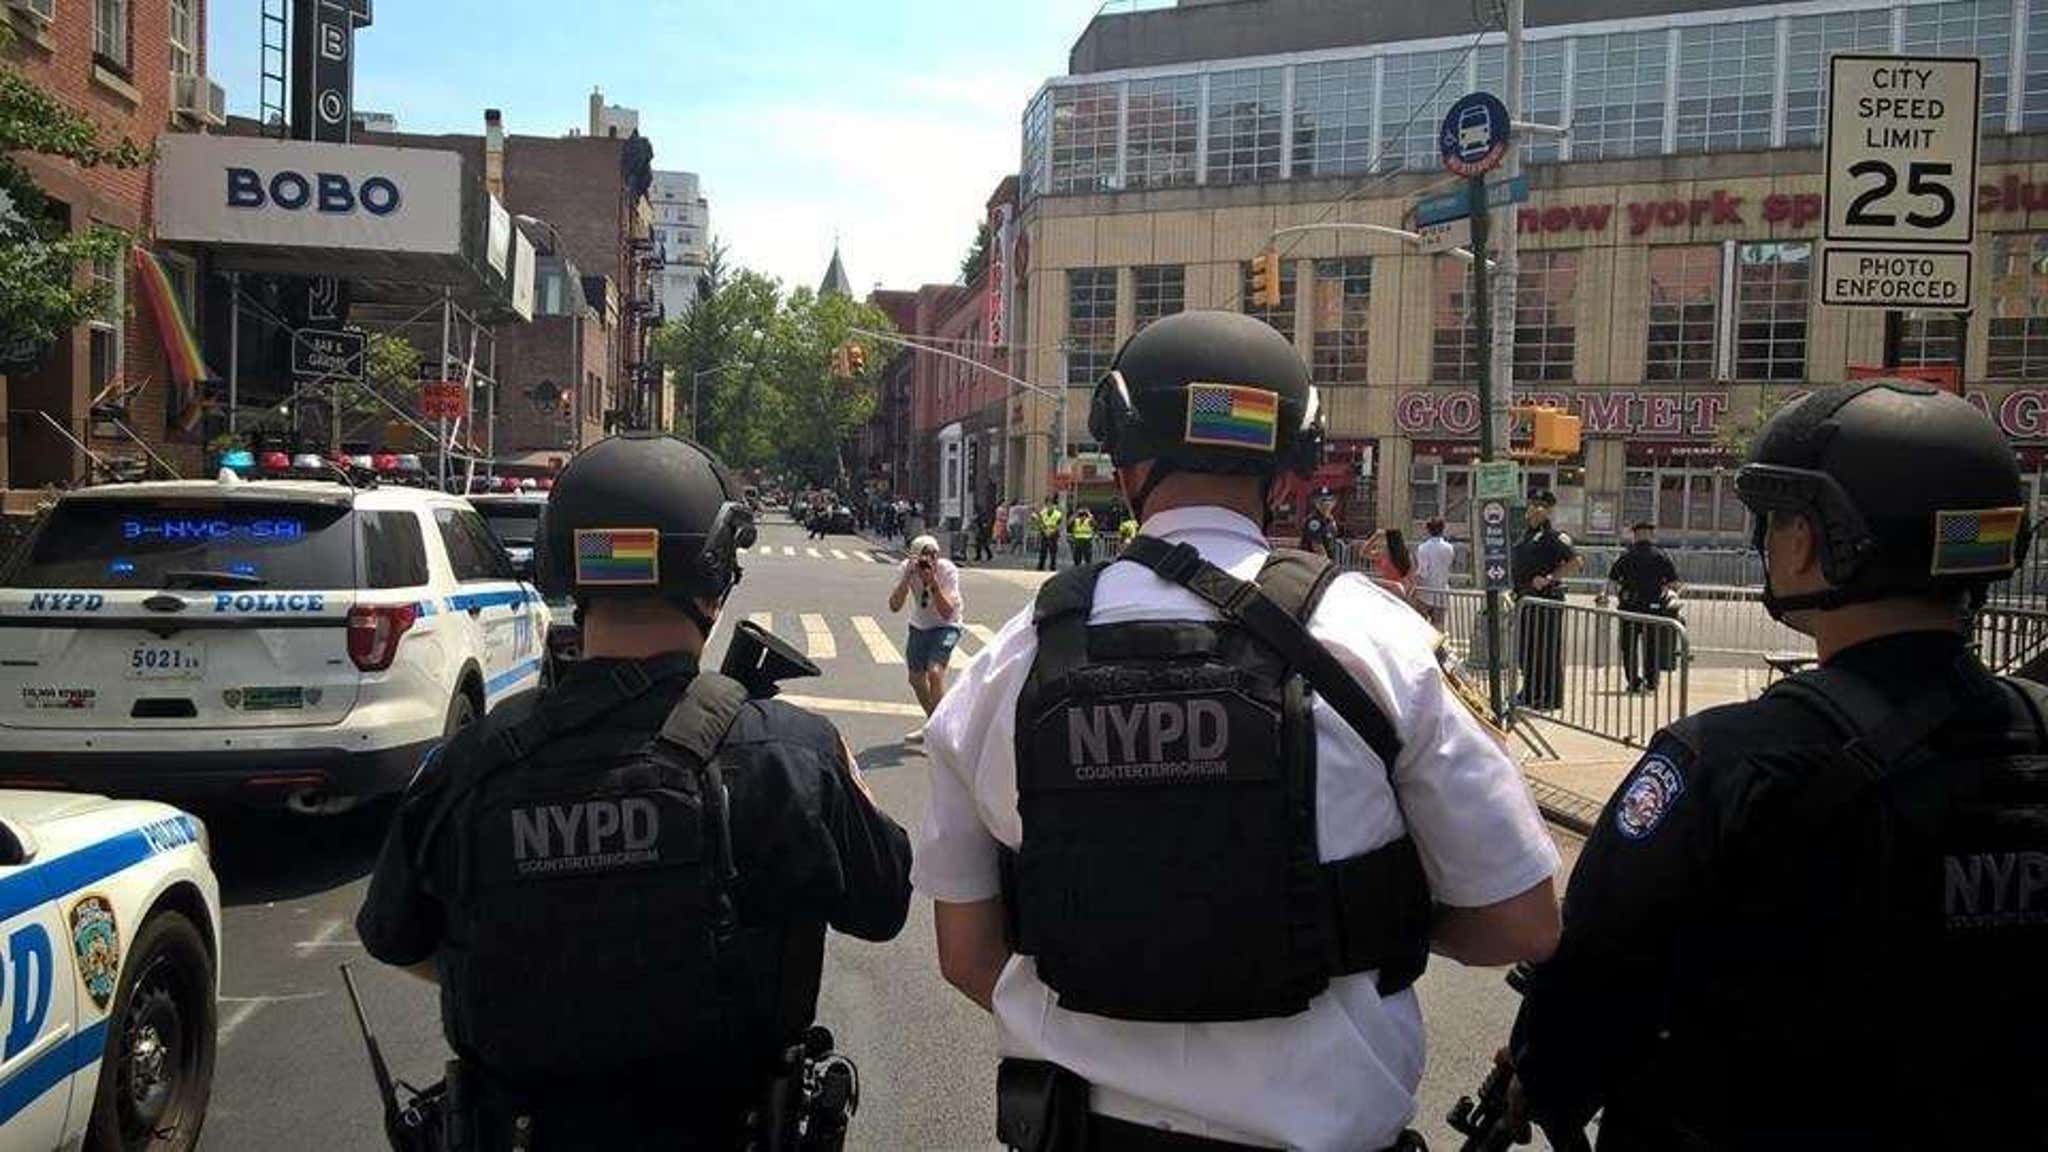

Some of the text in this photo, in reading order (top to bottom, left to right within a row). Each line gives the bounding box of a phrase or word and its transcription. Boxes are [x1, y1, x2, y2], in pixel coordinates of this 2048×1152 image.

[1872, 68, 1932, 89] CITY
[1859, 98, 1944, 119] SPEED
[1867, 127, 1935, 149] LIMIT
[225, 167, 400, 215] BOBO
[1845, 160, 1955, 228] 25
[1518, 202, 1610, 234] new
[1628, 190, 1745, 236] york
[1859, 257, 1934, 277] PHOTO
[1836, 279, 1956, 299] ENFORCED
[29, 594, 103, 611] NYPD
[214, 594, 323, 611] POLICE
[132, 649, 181, 668] 5021
[1068, 699, 1230, 765] NYPD
[512, 799, 660, 859] NYPD
[1944, 851, 2048, 914] NYP
